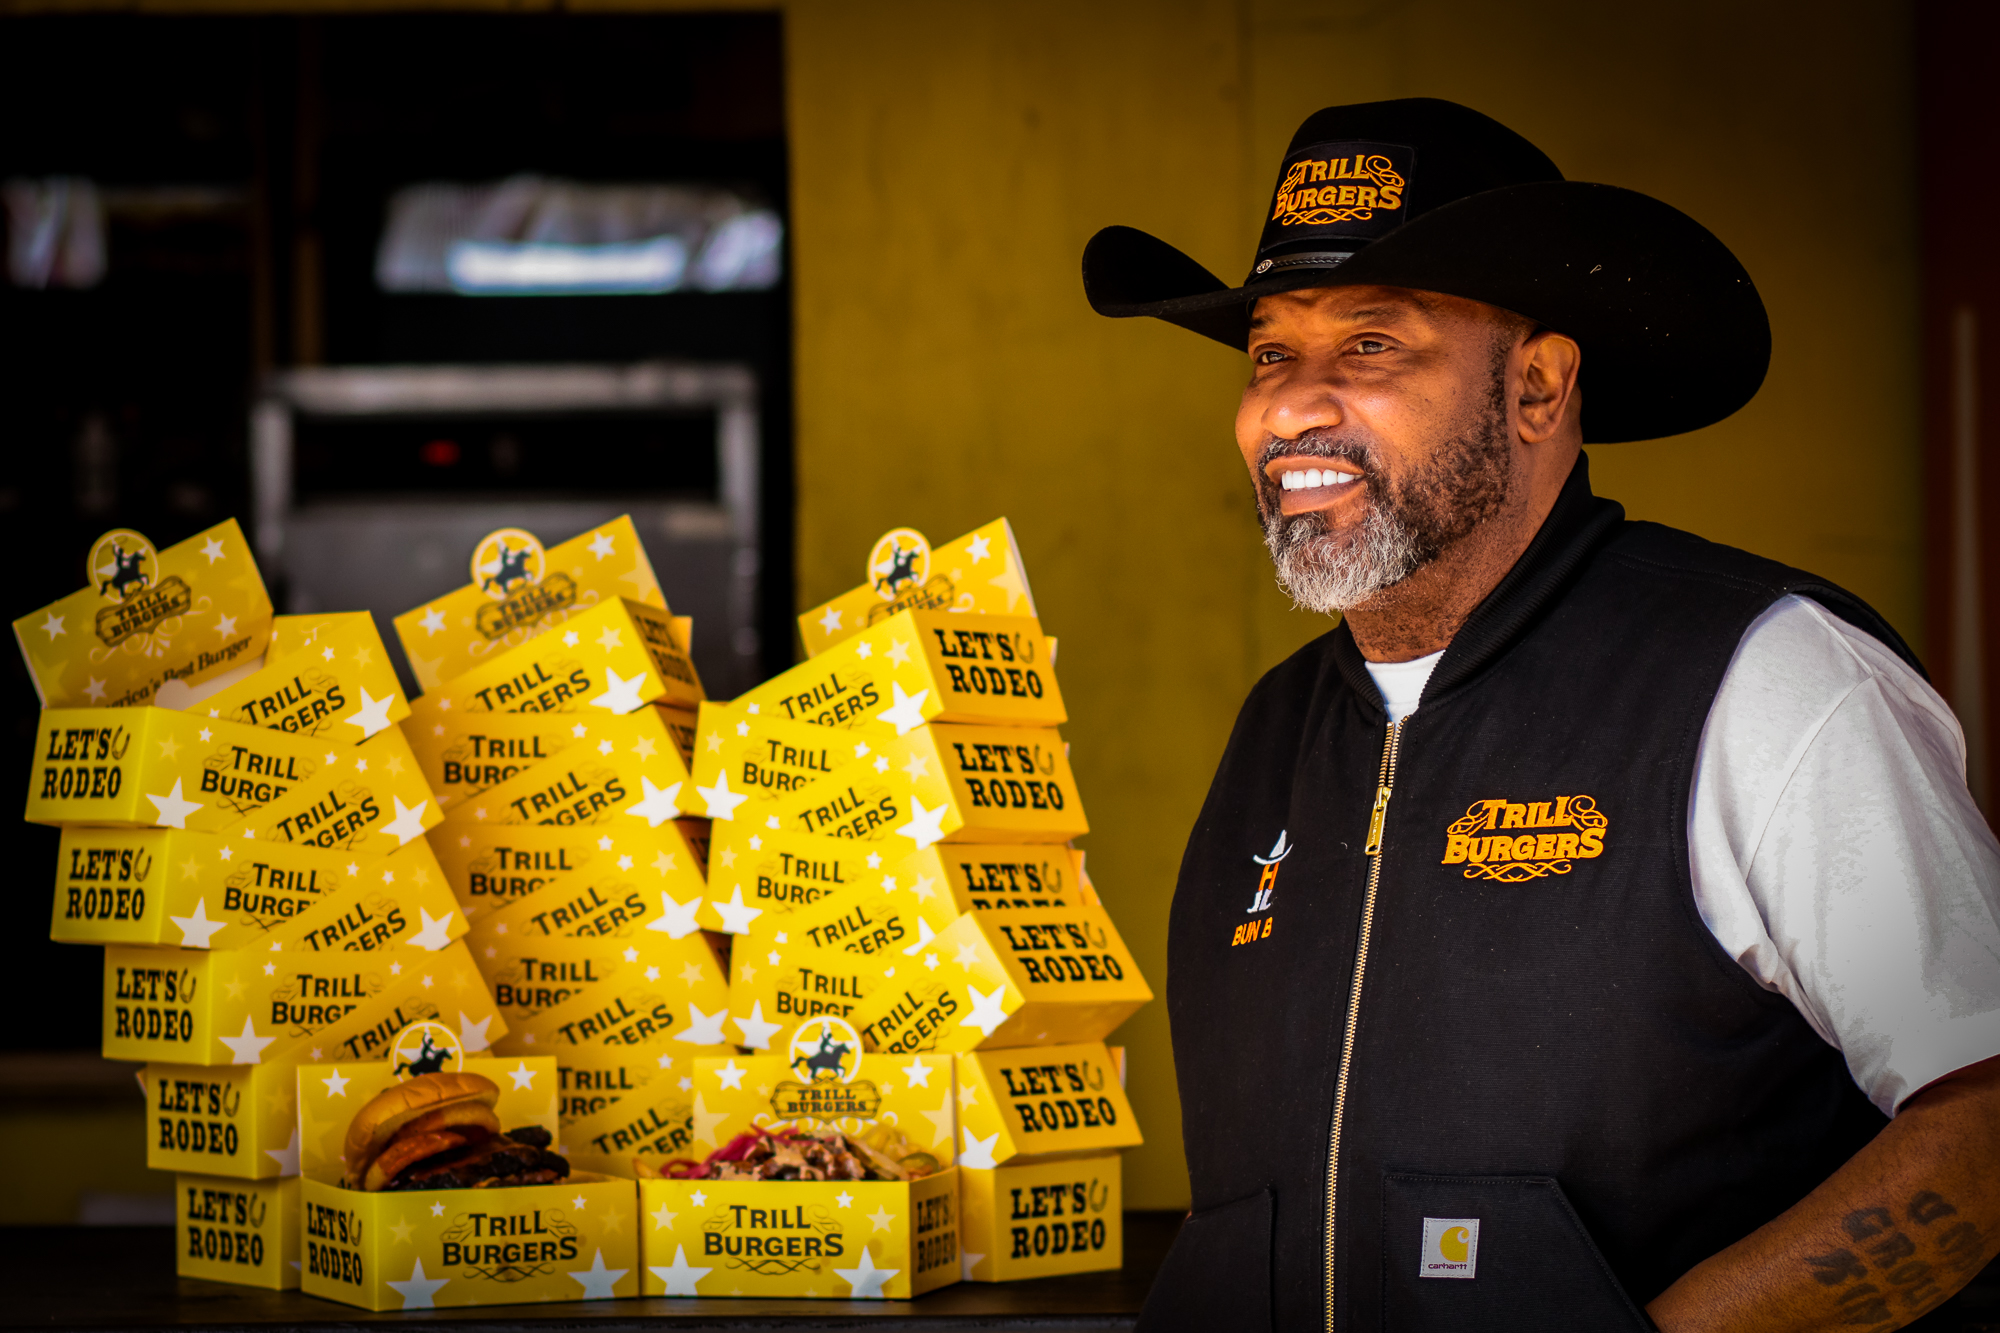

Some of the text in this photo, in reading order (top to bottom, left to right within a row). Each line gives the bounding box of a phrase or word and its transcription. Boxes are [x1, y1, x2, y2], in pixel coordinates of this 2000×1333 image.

[1297, 154, 1370, 184] TRILL
[1272, 186, 1403, 221] BURGERS
[110, 596, 180, 637] BURGERS
[116, 591, 167, 621] TRILL
[198, 636, 252, 670] Burger
[934, 628, 1014, 662] LET'S
[474, 662, 553, 712] TRILL
[506, 669, 591, 713] GERS
[780, 672, 848, 720] TRILL
[945, 664, 1043, 699] RODEO
[242, 676, 312, 725] TRILL
[265, 686, 346, 734] GERS
[812, 682, 879, 728] GERS
[47, 726, 112, 761] LET'S
[468, 735, 546, 759] TRILL
[767, 740, 832, 772] TRILL
[952, 742, 1036, 774] LET'S
[230, 745, 299, 781] TRILL
[41, 766, 122, 800] RODEO
[511, 771, 588, 822] TRILL
[965, 778, 1064, 811] RODEO
[277, 789, 346, 842] TRILL
[536, 778, 627, 826] GERS
[799, 786, 866, 834] TRILL
[826, 796, 898, 839] GERS
[1482, 795, 1573, 830] TRILL
[302, 796, 380, 847] GERS
[494, 847, 573, 870] TRILL
[1442, 828, 1606, 864] BURGERS
[69, 849, 134, 882] LET'S
[252, 863, 321, 893] TRILL
[780, 853, 844, 884] TRILL
[961, 863, 1042, 892] LET'S
[66, 888, 145, 920] RODEO
[532, 888, 608, 936] TRILL
[304, 903, 373, 951] TRILL
[807, 905, 872, 948] TRILL
[1000, 923, 1086, 952] LET'S
[1232, 916, 1272, 946] BUN B
[116, 968, 178, 1000] LET'S
[296, 974, 367, 997] TRILL
[520, 958, 599, 982] TRILL
[799, 969, 864, 1000] TRILL
[1018, 954, 1124, 984] RODEO
[115, 1006, 194, 1042] RODEO
[344, 1007, 413, 1058] TRILL
[558, 998, 635, 1046] TRILL
[863, 990, 924, 1046] TRILL
[558, 1067, 634, 1090] TRILL
[799, 1089, 856, 1100] TRILL
[1001, 1064, 1084, 1097] LET'S
[158, 1080, 222, 1115] LET'S
[788, 1101, 867, 1113] BURGERS
[592, 1108, 669, 1154] TRILL
[1016, 1099, 1117, 1132] RODEO
[158, 1118, 239, 1156] RODEO
[188, 1188, 248, 1224] LET'S
[728, 1205, 811, 1230] TRILL
[917, 1194, 952, 1233] LET'S
[1010, 1183, 1087, 1220] LET'S
[308, 1201, 348, 1244] LET'S
[468, 1210, 548, 1236] TRILL
[1010, 1219, 1106, 1260] RODEO
[188, 1224, 264, 1266] RODEO
[442, 1236, 578, 1267] BURGERS
[704, 1230, 844, 1258] BURGERS
[917, 1230, 956, 1274] RODEO
[308, 1243, 363, 1286] RODEO
